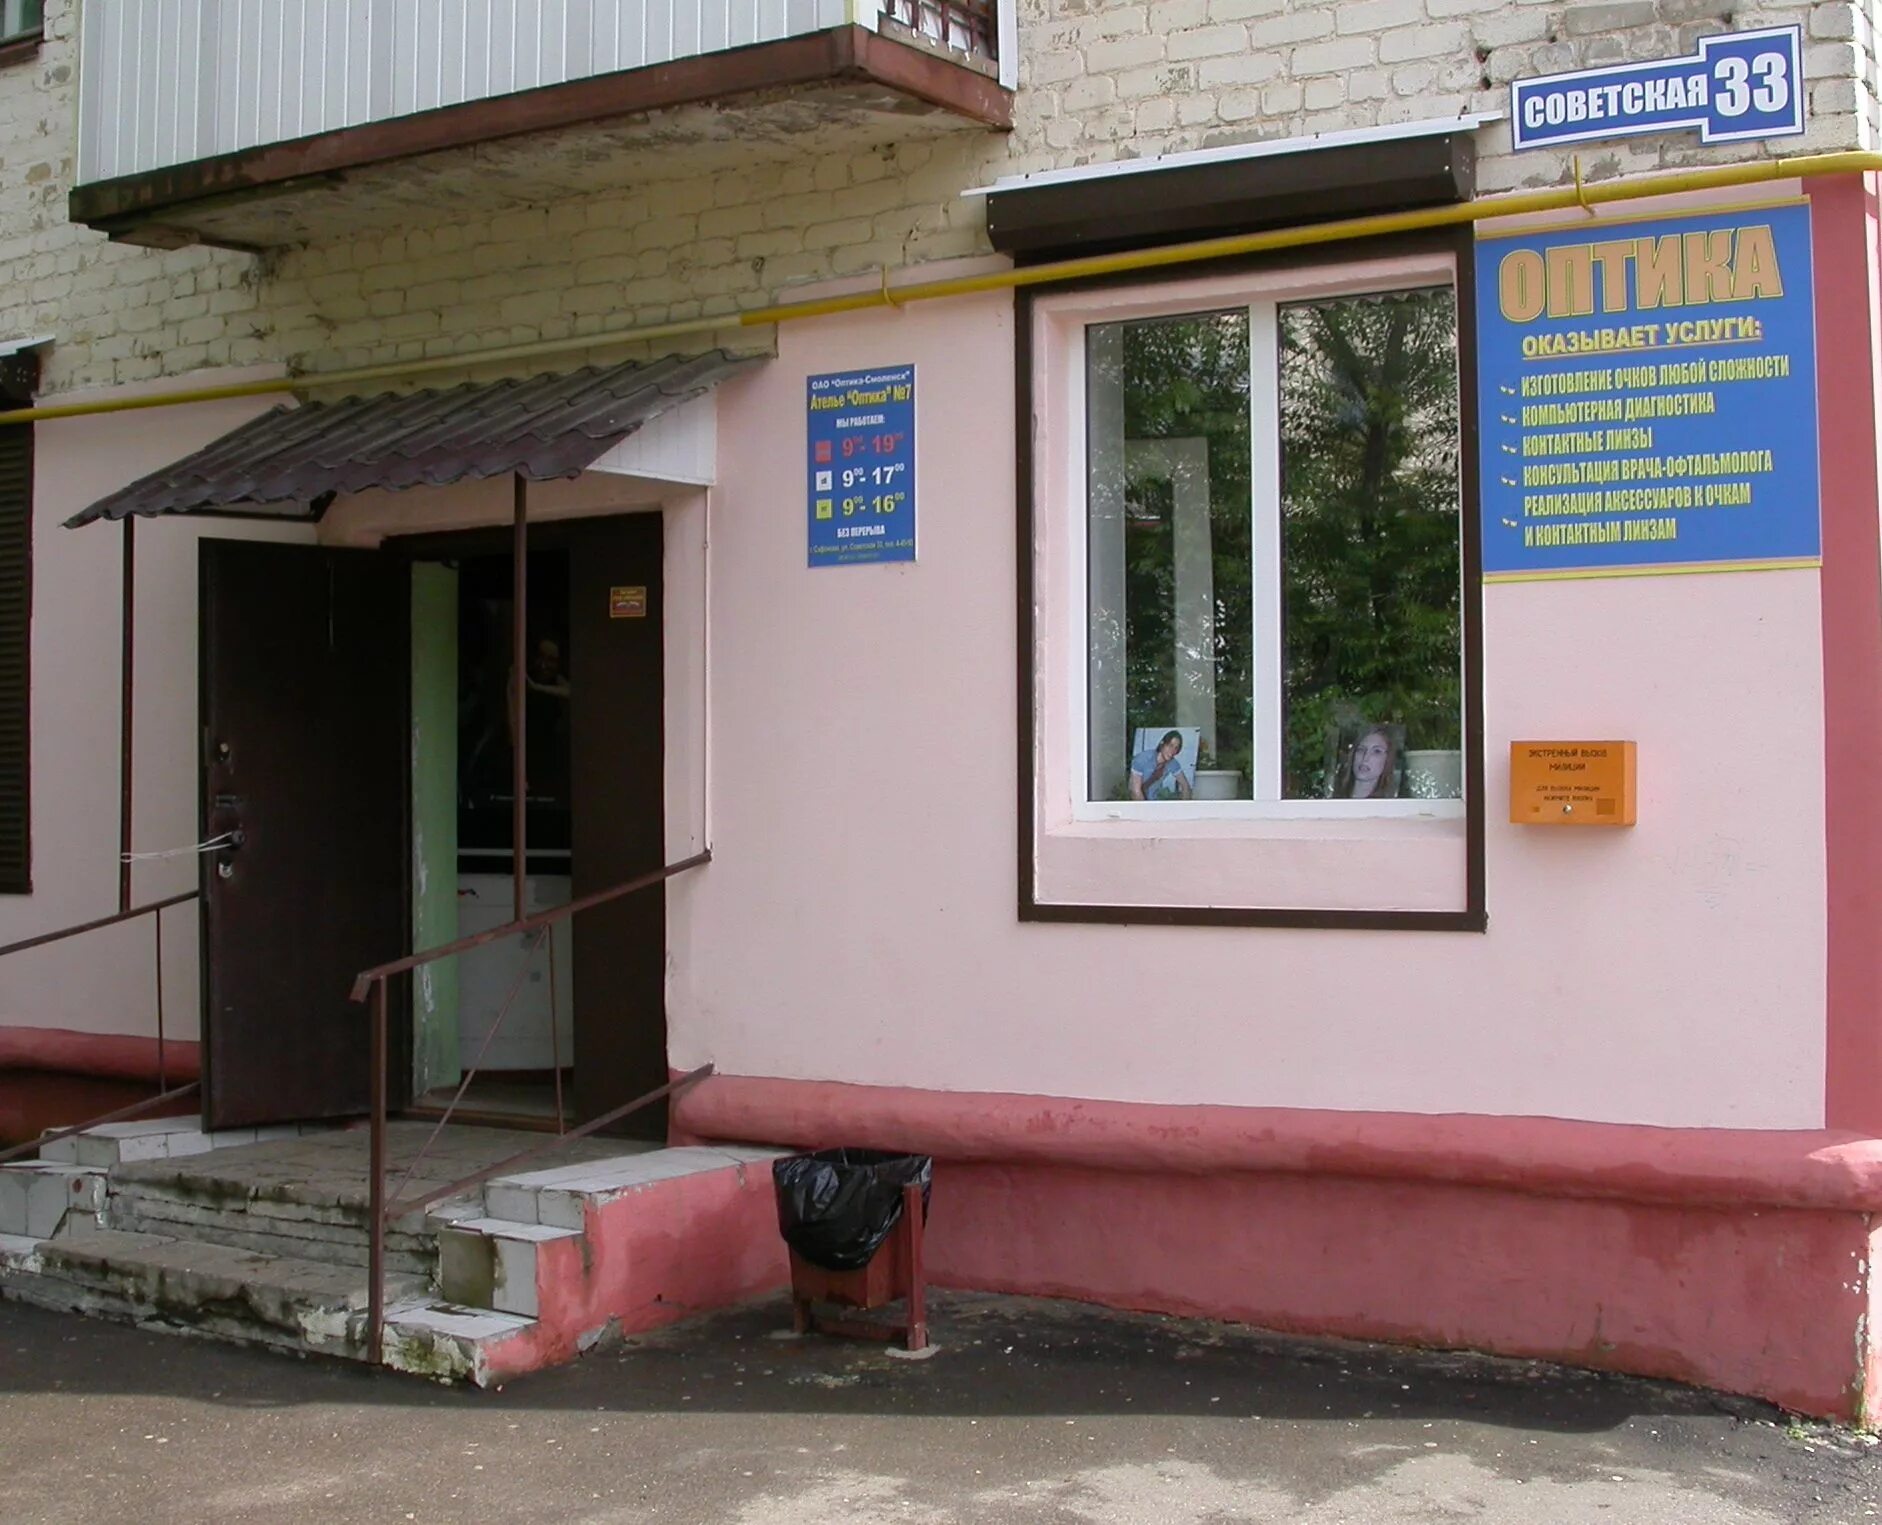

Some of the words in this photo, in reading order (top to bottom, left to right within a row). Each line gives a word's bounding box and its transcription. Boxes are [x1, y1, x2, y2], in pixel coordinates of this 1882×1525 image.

[1524, 73, 1708, 128] СОВЕТСКАЯ
[1714, 52, 1788, 116] 33
[1499, 224, 1783, 322] ОПТИКА
[1522, 324, 1659, 357] ОКАЗЫВАЕТ
[1666, 316, 1762, 345] УСЛУГИ:
[811, 380, 830, 390] ОАО
[1521, 368, 1612, 397] ИЗГОТОВЛЕНИЕ
[1614, 366, 1657, 390] ОЧКОВ
[1658, 358, 1706, 385] ЛЮБОЙ
[1709, 355, 1790, 381] СЛОЖНОСТИ
[810, 393, 846, 410] Ателье
[847, 385, 892, 406] "Оптика"
[893, 383, 912, 401] №7
[1522, 399, 1623, 427] КОМПЬЮТЕРНАЯ
[1624, 391, 1715, 422] ДИАГНОСТИКА
[836, 418, 849, 429] МЫ
[1522, 430, 1604, 456] КОНТАКТНЫЕ
[1606, 426, 1653, 451] ЛИНЗЫ
[1523, 459, 1620, 487] КОНСУЛЬТАЦИЯ
[1621, 449, 1773, 481] ВРАЧА-ОФТАЛЬМОЛОГА
[1524, 491, 1603, 516] РЕАЛИЗАЦИЯ
[1604, 486, 1692, 513] АКСЕССУАРОВ
[1694, 485, 1703, 507] К
[1705, 482, 1751, 506] ОЧКАМ
[837, 528, 850, 538] БЕЗ
[850, 525, 886, 537] ПЕРЕРЫВА
[1525, 525, 1534, 547] И
[1535, 521, 1622, 546] КОНТАКТНЫМ
[1624, 517, 1677, 541] ЛИНЗАМ
